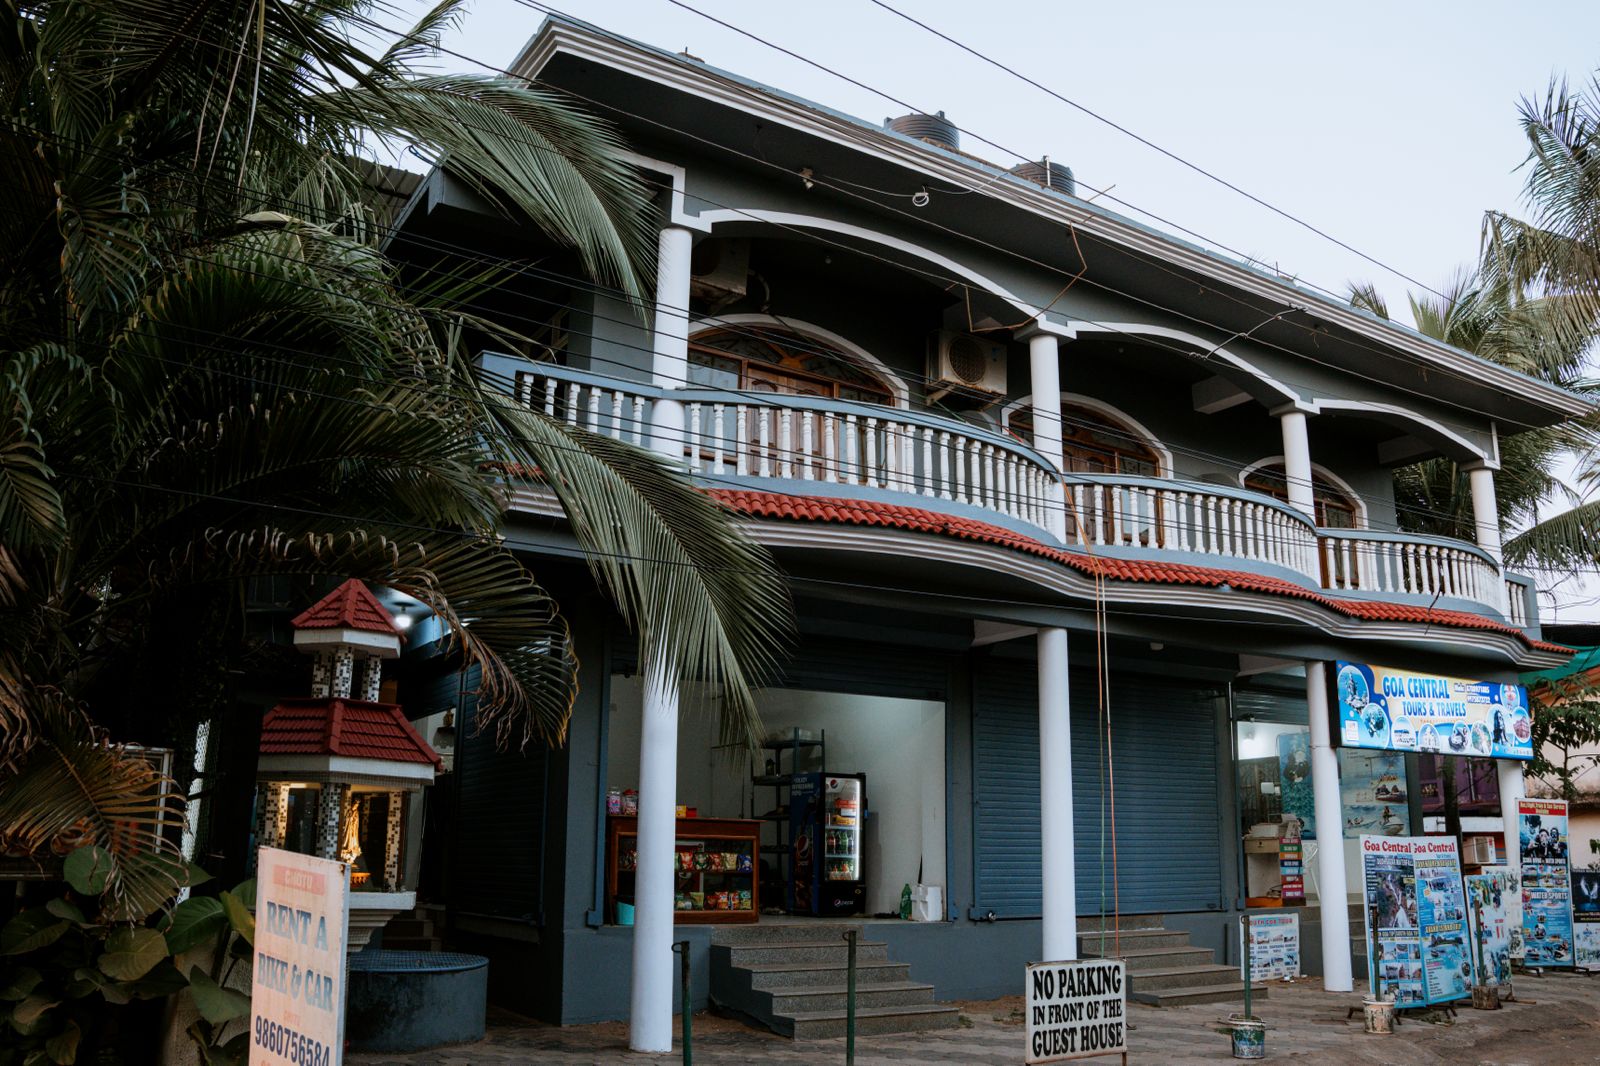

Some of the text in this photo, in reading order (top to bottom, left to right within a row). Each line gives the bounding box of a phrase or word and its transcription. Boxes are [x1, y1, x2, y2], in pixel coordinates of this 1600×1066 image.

[1382, 676, 1406, 698] GOA
[1408, 678, 1450, 699] CENTRAL
[1402, 700, 1466, 717] TOURS & TRAVELS
[1364, 840, 1411, 853] Goa Central
[1428, 842, 1455, 852] Central
[1548, 892, 1568, 900] SPORTS
[266, 901, 328, 952] RENT A
[256, 952, 333, 1012] BIKE & CAR
[1033, 965, 1122, 1000] NO PARKING
[1033, 999, 1122, 1026] IN FRONT OF THE
[255, 1015, 330, 1066] 9860756584
[1033, 1022, 1123, 1057] GUEST HOUSE
